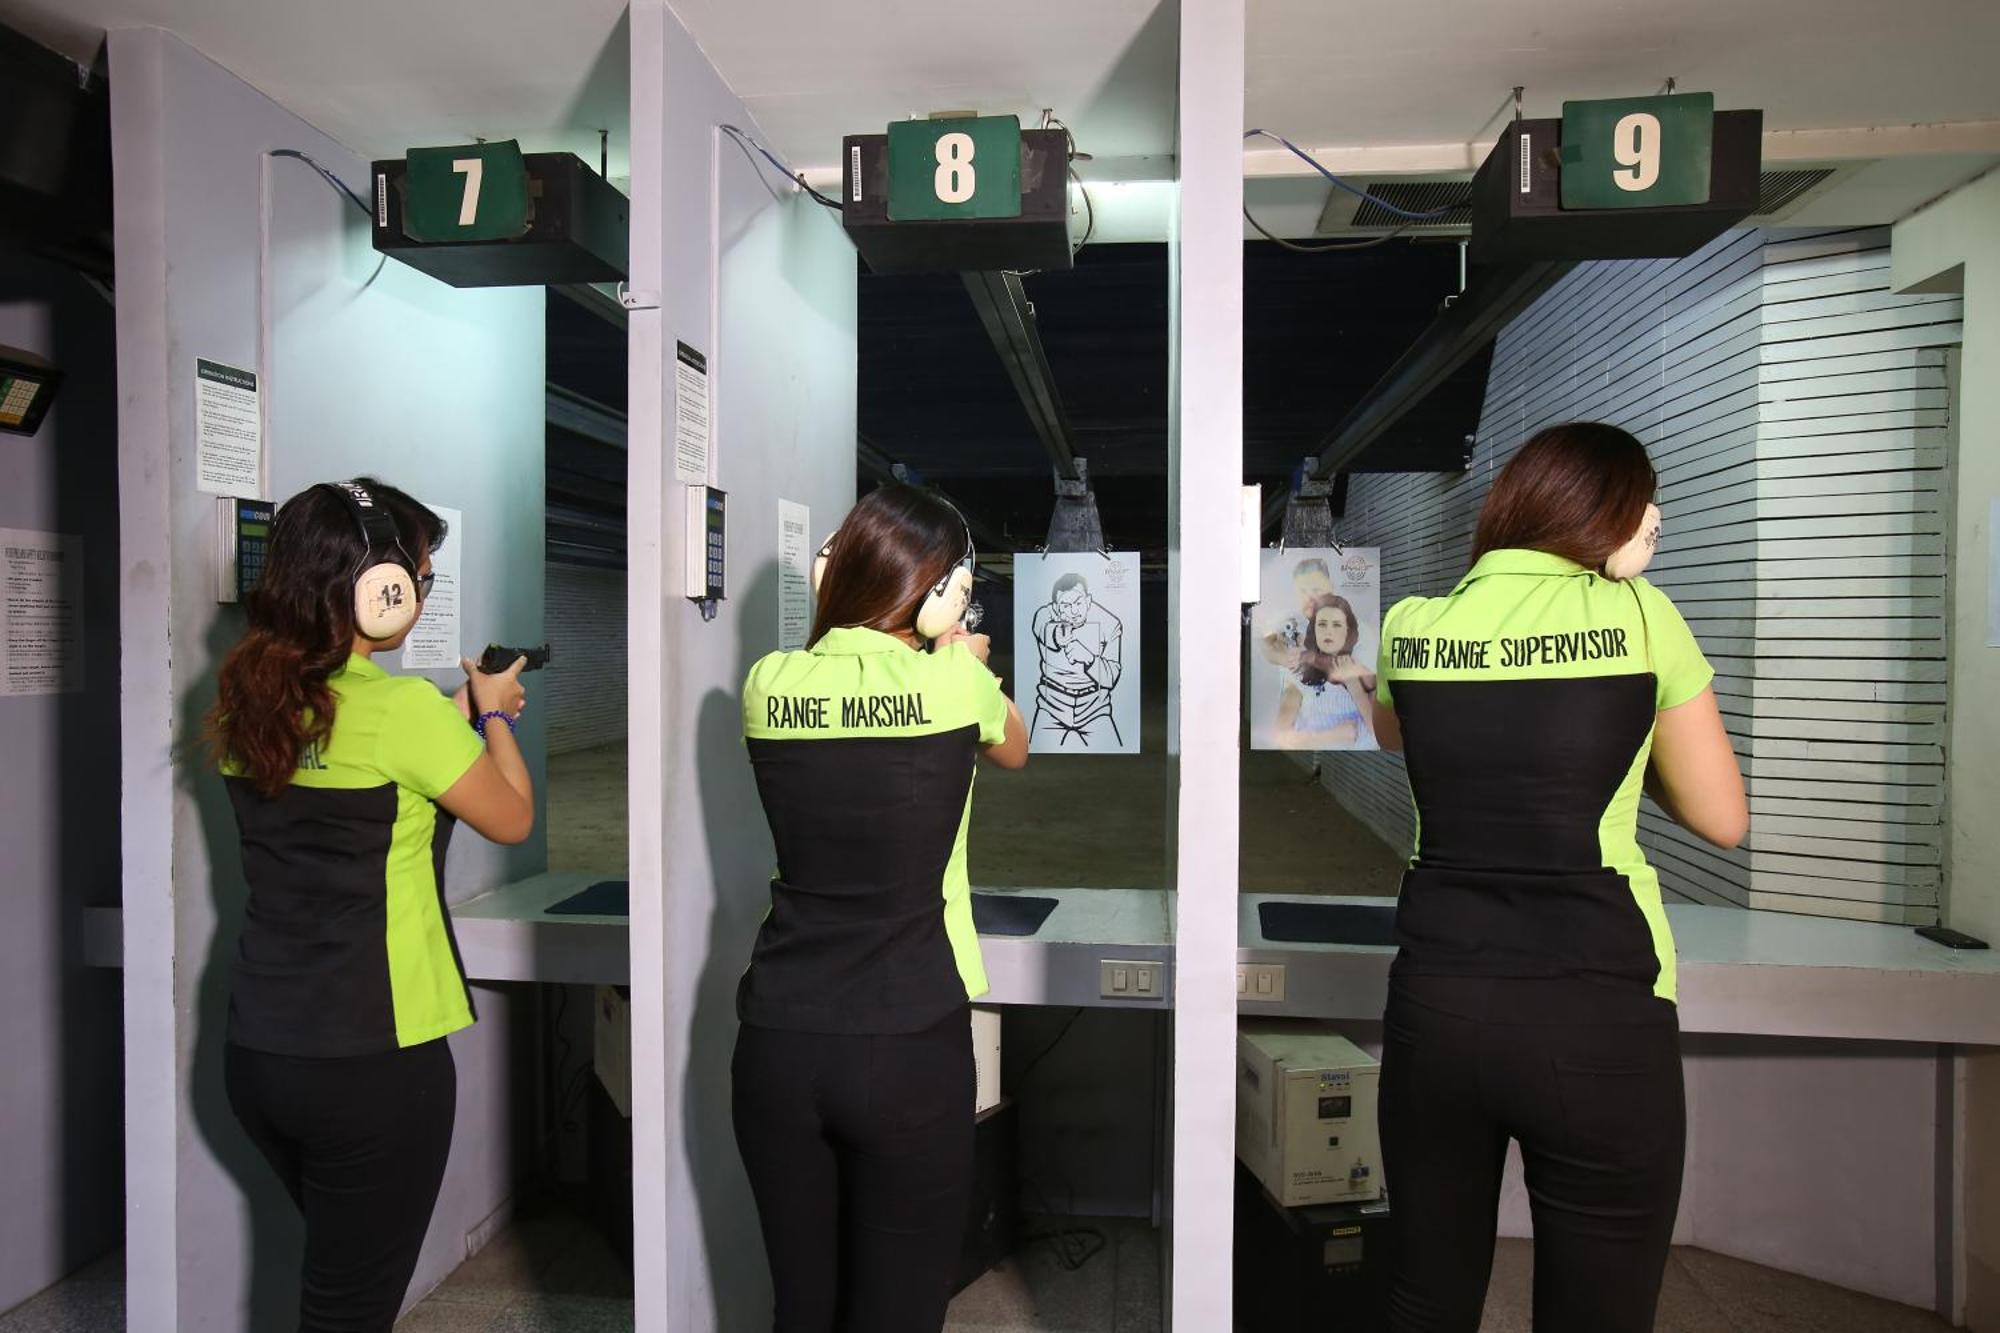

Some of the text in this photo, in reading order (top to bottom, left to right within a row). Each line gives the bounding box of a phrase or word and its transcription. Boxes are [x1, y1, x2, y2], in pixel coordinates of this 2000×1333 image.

[934, 132, 976, 204] 8
[1613, 112, 1661, 192] 9
[452, 158, 483, 226] 7
[381, 583, 403, 607] 12
[1391, 627, 1628, 669] FIRING RANGE SUPERVISOR
[767, 692, 932, 728] RANGE MARSHAL
